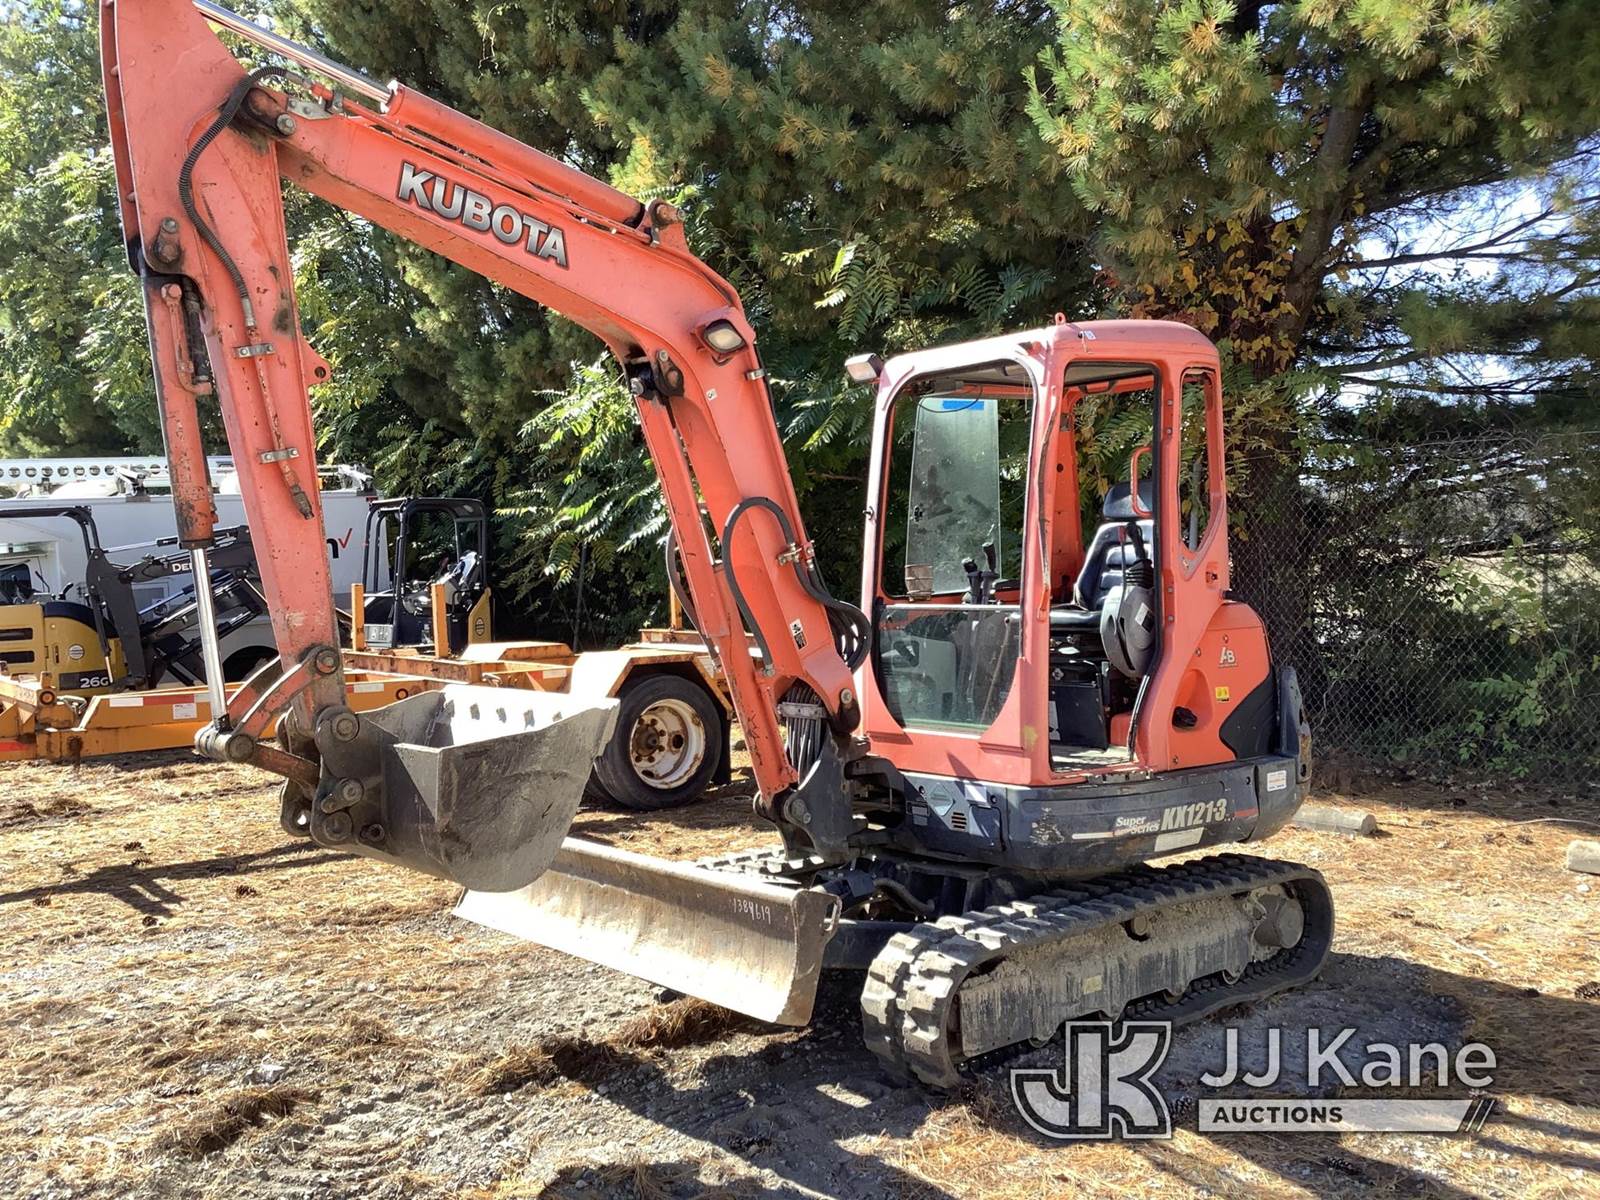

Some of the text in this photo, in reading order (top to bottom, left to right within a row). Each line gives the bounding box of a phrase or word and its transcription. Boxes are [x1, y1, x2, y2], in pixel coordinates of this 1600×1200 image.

[398, 162, 569, 267] KUBOTA
[80, 677, 109, 688] 26G
[1116, 816, 1147, 828] Super
